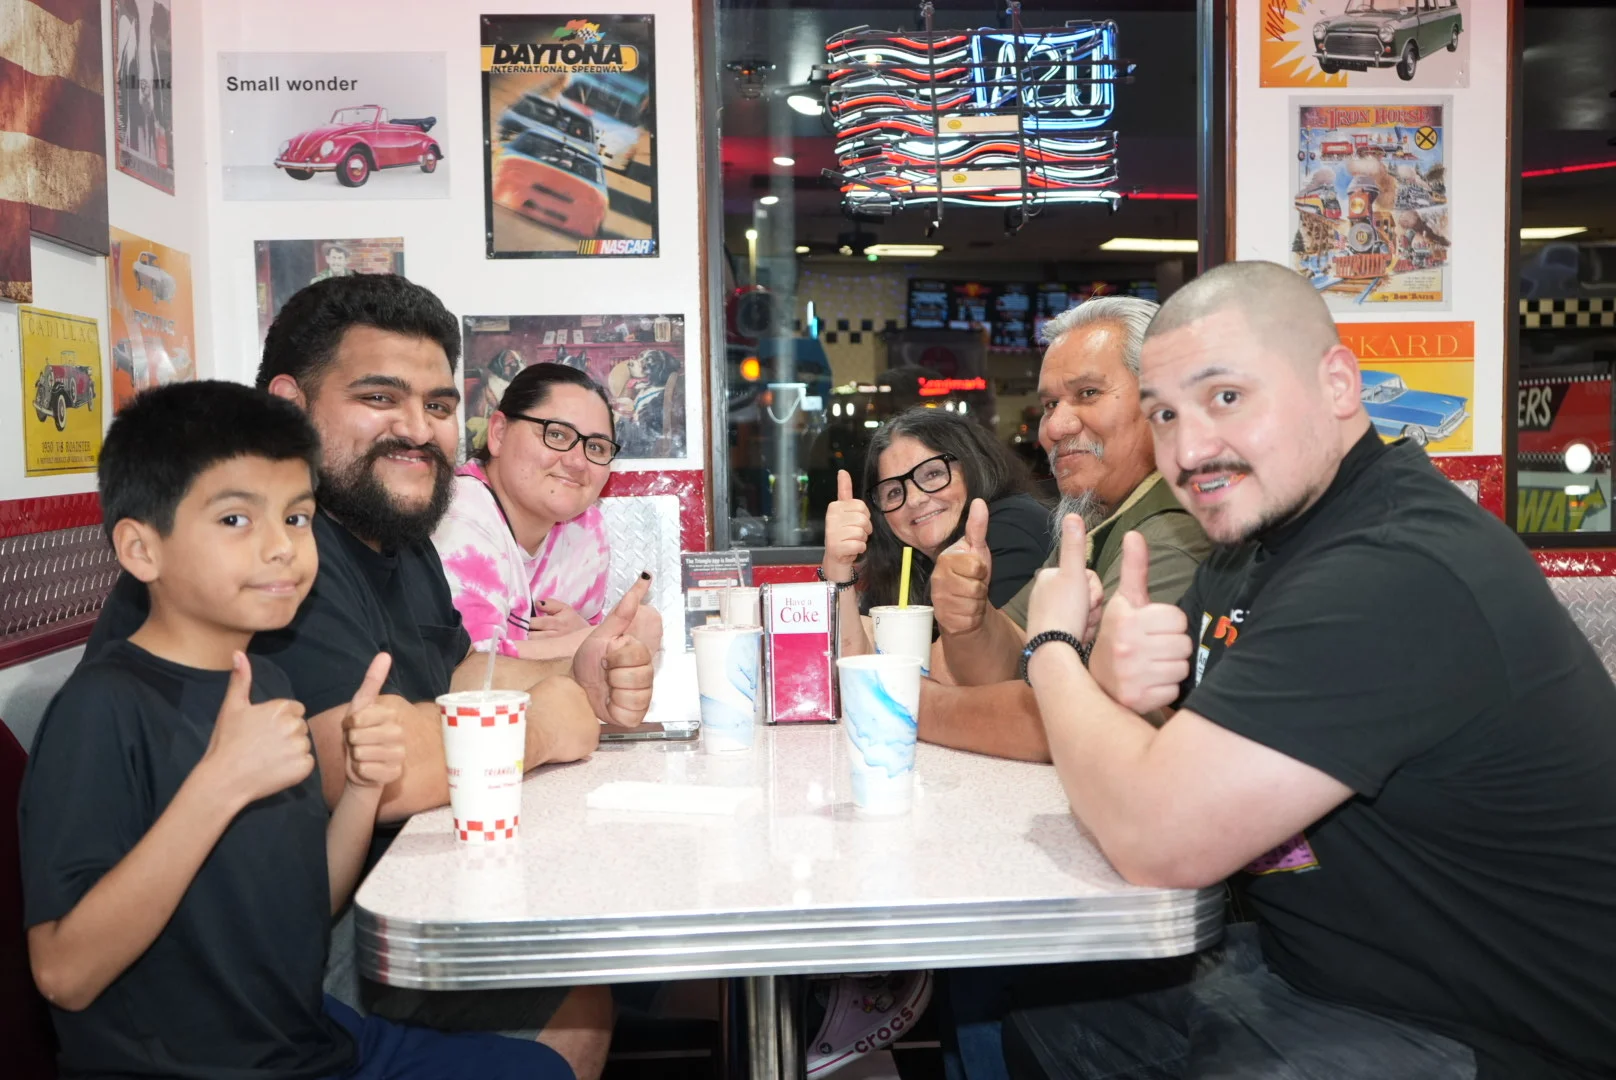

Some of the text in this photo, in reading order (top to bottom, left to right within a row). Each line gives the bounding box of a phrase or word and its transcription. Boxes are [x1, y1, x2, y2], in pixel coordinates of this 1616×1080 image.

[492, 43, 624, 66] DAYTONA
[490, 65, 624, 74] INTERNATIONAL SPEEDWAY
[226, 76, 358, 92] Small wonder
[1326, 108, 1370, 131] IRON
[1375, 106, 1429, 125] HORSE
[600, 239, 651, 255] NASCAR
[28, 316, 95, 344] CADILLAC
[785, 597, 806, 606] Have
[780, 606, 819, 623] Coke
[854, 1006, 914, 1054] crocs
